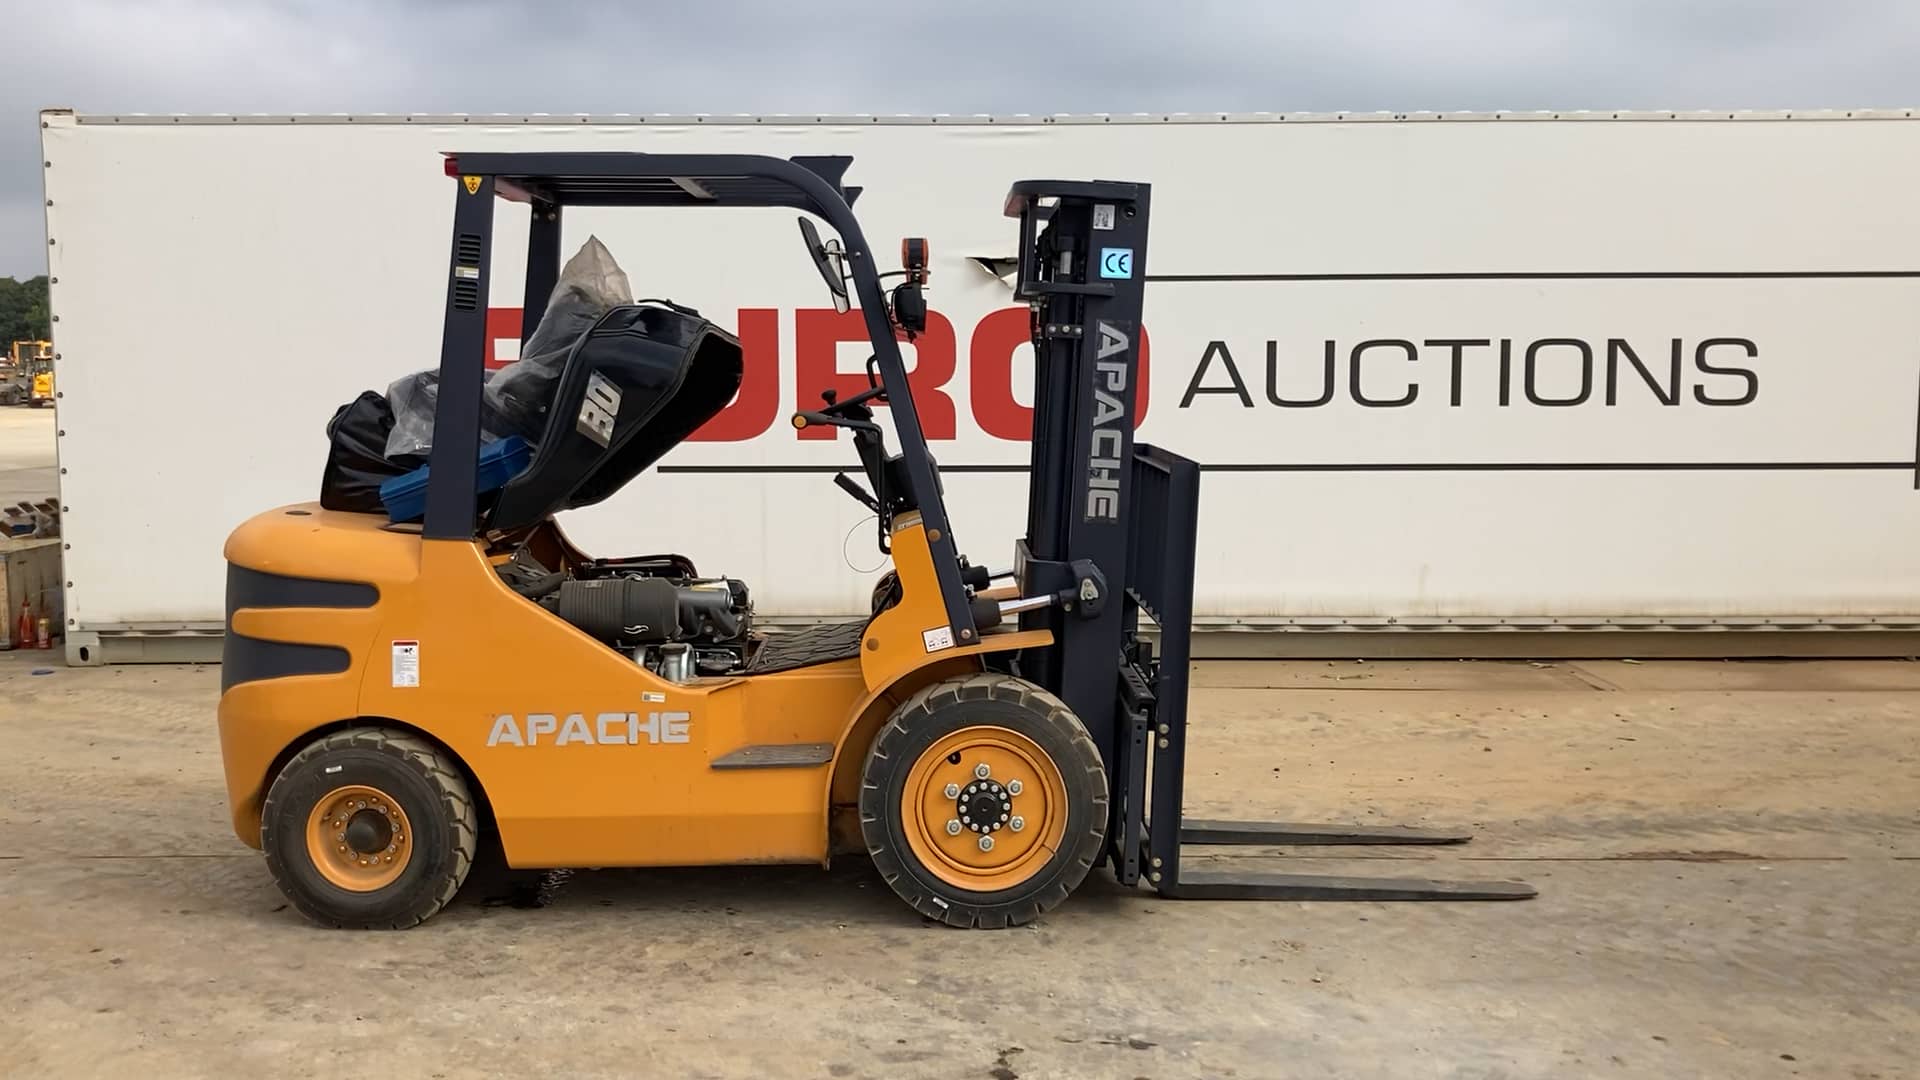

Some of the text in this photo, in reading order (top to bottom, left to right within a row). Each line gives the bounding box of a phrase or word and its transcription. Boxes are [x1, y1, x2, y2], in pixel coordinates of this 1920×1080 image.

[1104, 252, 1130, 274] CE
[485, 307, 1760, 442] URO AUCTIONS
[1087, 321, 1129, 519] APACHE
[486, 711, 691, 747] APACHE
